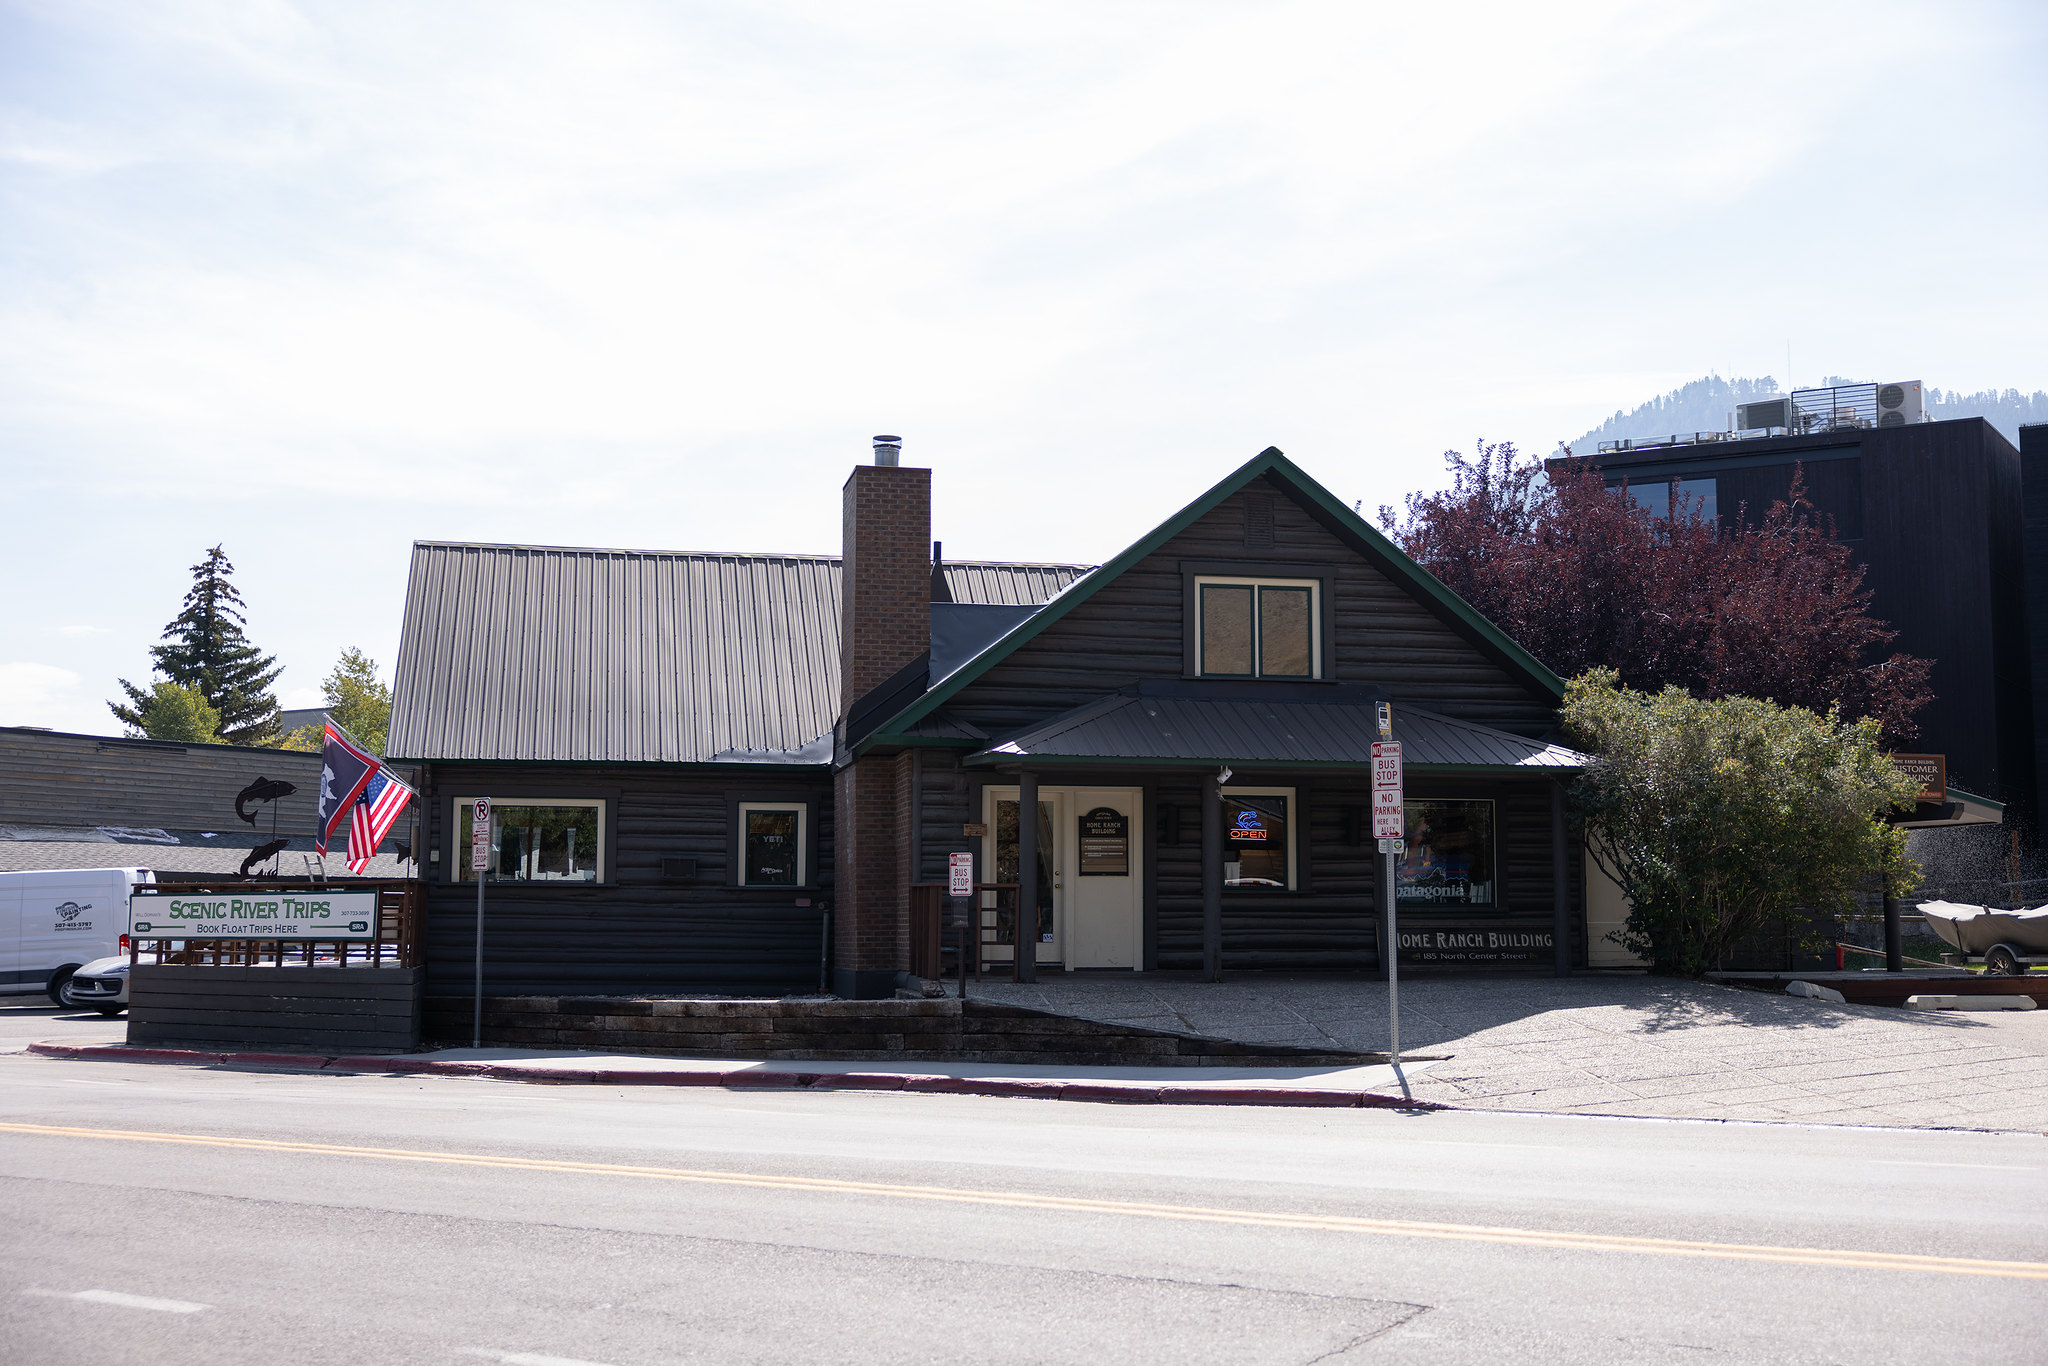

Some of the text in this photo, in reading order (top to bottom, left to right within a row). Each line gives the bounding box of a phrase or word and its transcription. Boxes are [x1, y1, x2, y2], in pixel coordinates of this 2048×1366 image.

[1373, 746, 1381, 755] NO
[1378, 761, 1395, 769] BUS
[1376, 771, 1397, 780] STOP
[1382, 794, 1393, 802] NO
[1375, 806, 1400, 815] PARKING
[953, 878, 969, 886] STOP
[64, 904, 92, 916] PAINTING
[169, 898, 330, 919] SCENIC RIVER TRIPS
[197, 924, 298, 934] BOOK FLOAT TRIPS HERE
[1437, 932, 1483, 949] RANCH
[1488, 932, 1552, 948] BUILDING
